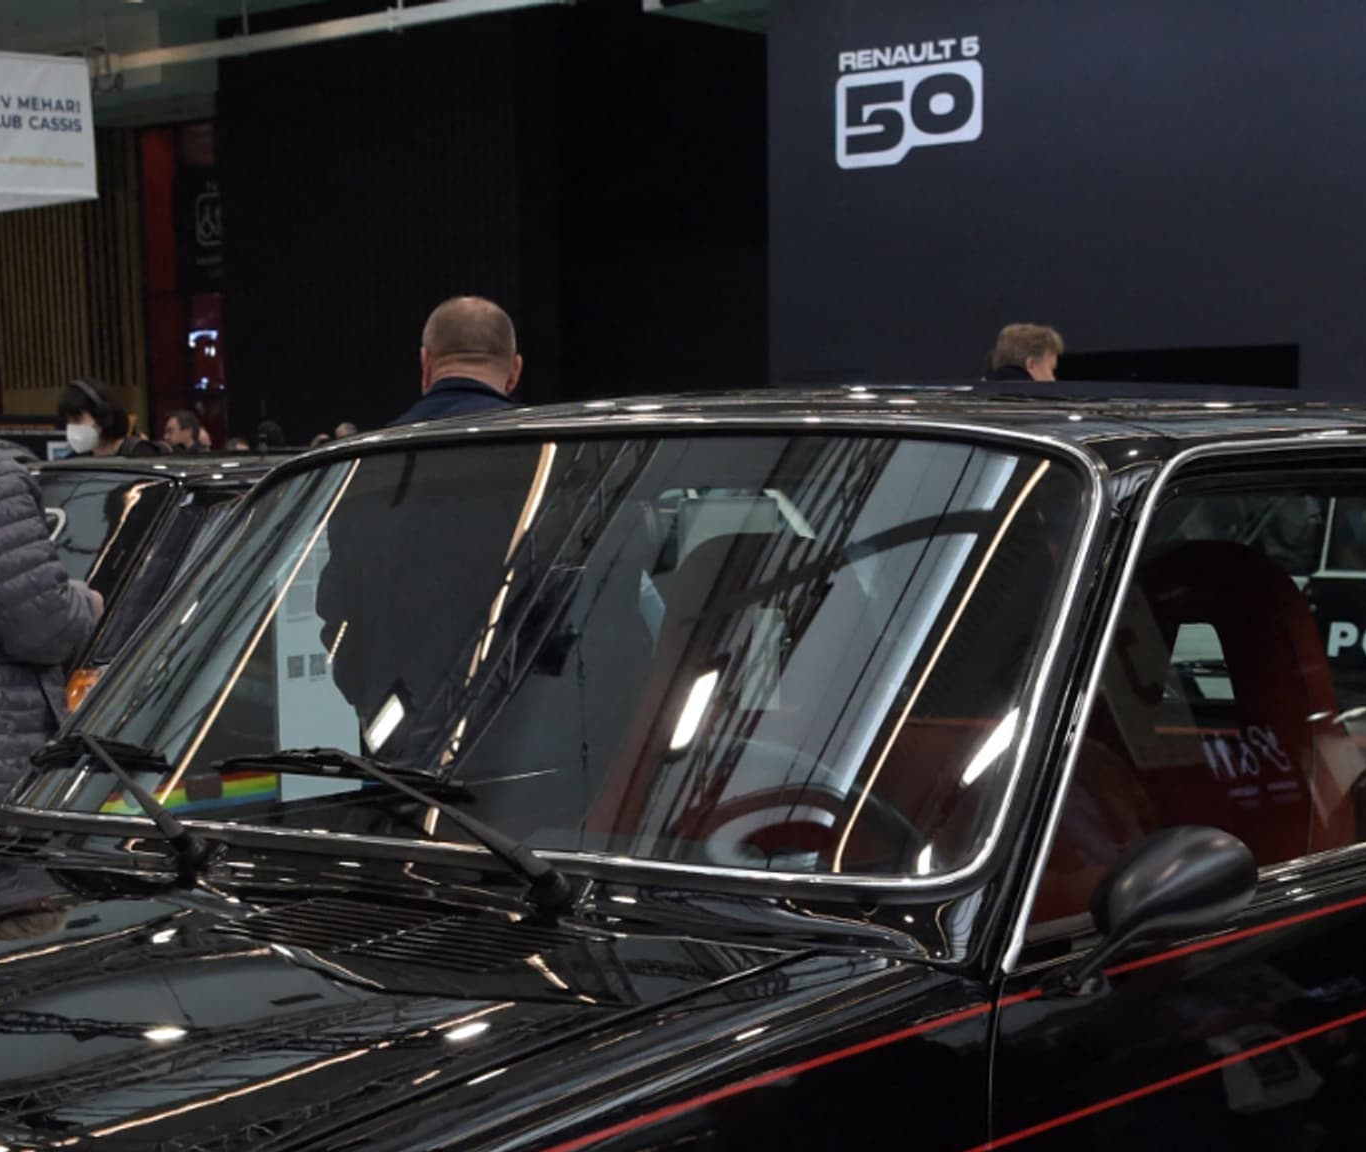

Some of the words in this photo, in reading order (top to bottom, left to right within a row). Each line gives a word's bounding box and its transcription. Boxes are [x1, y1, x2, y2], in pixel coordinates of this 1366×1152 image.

[838, 39, 956, 72] RENAULT
[960, 36, 980, 58] 5
[17, 97, 80, 113] MEHARI
[845, 72, 975, 156] 50
[28, 116, 82, 133] CASSIS
